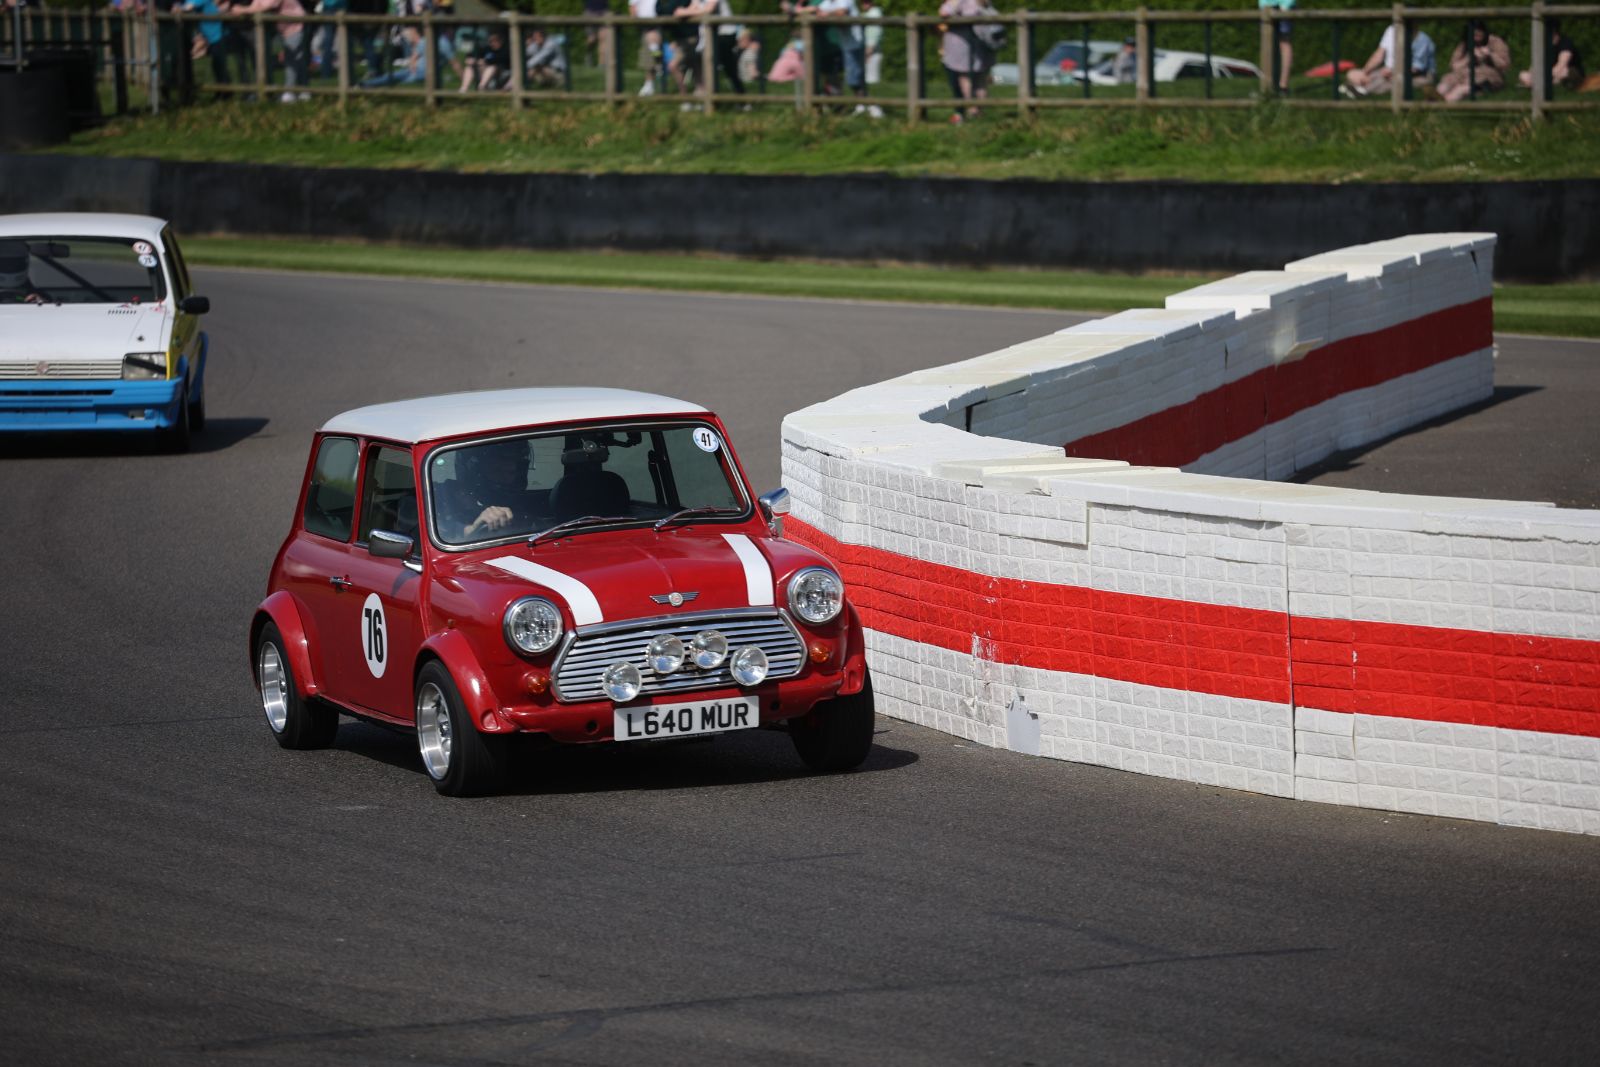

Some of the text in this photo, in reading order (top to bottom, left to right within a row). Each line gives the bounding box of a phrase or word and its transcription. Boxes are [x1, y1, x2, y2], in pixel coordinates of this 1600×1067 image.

[701, 432, 712, 447] 41
[364, 607, 384, 664] 76
[626, 702, 749, 738] L640 MUR
